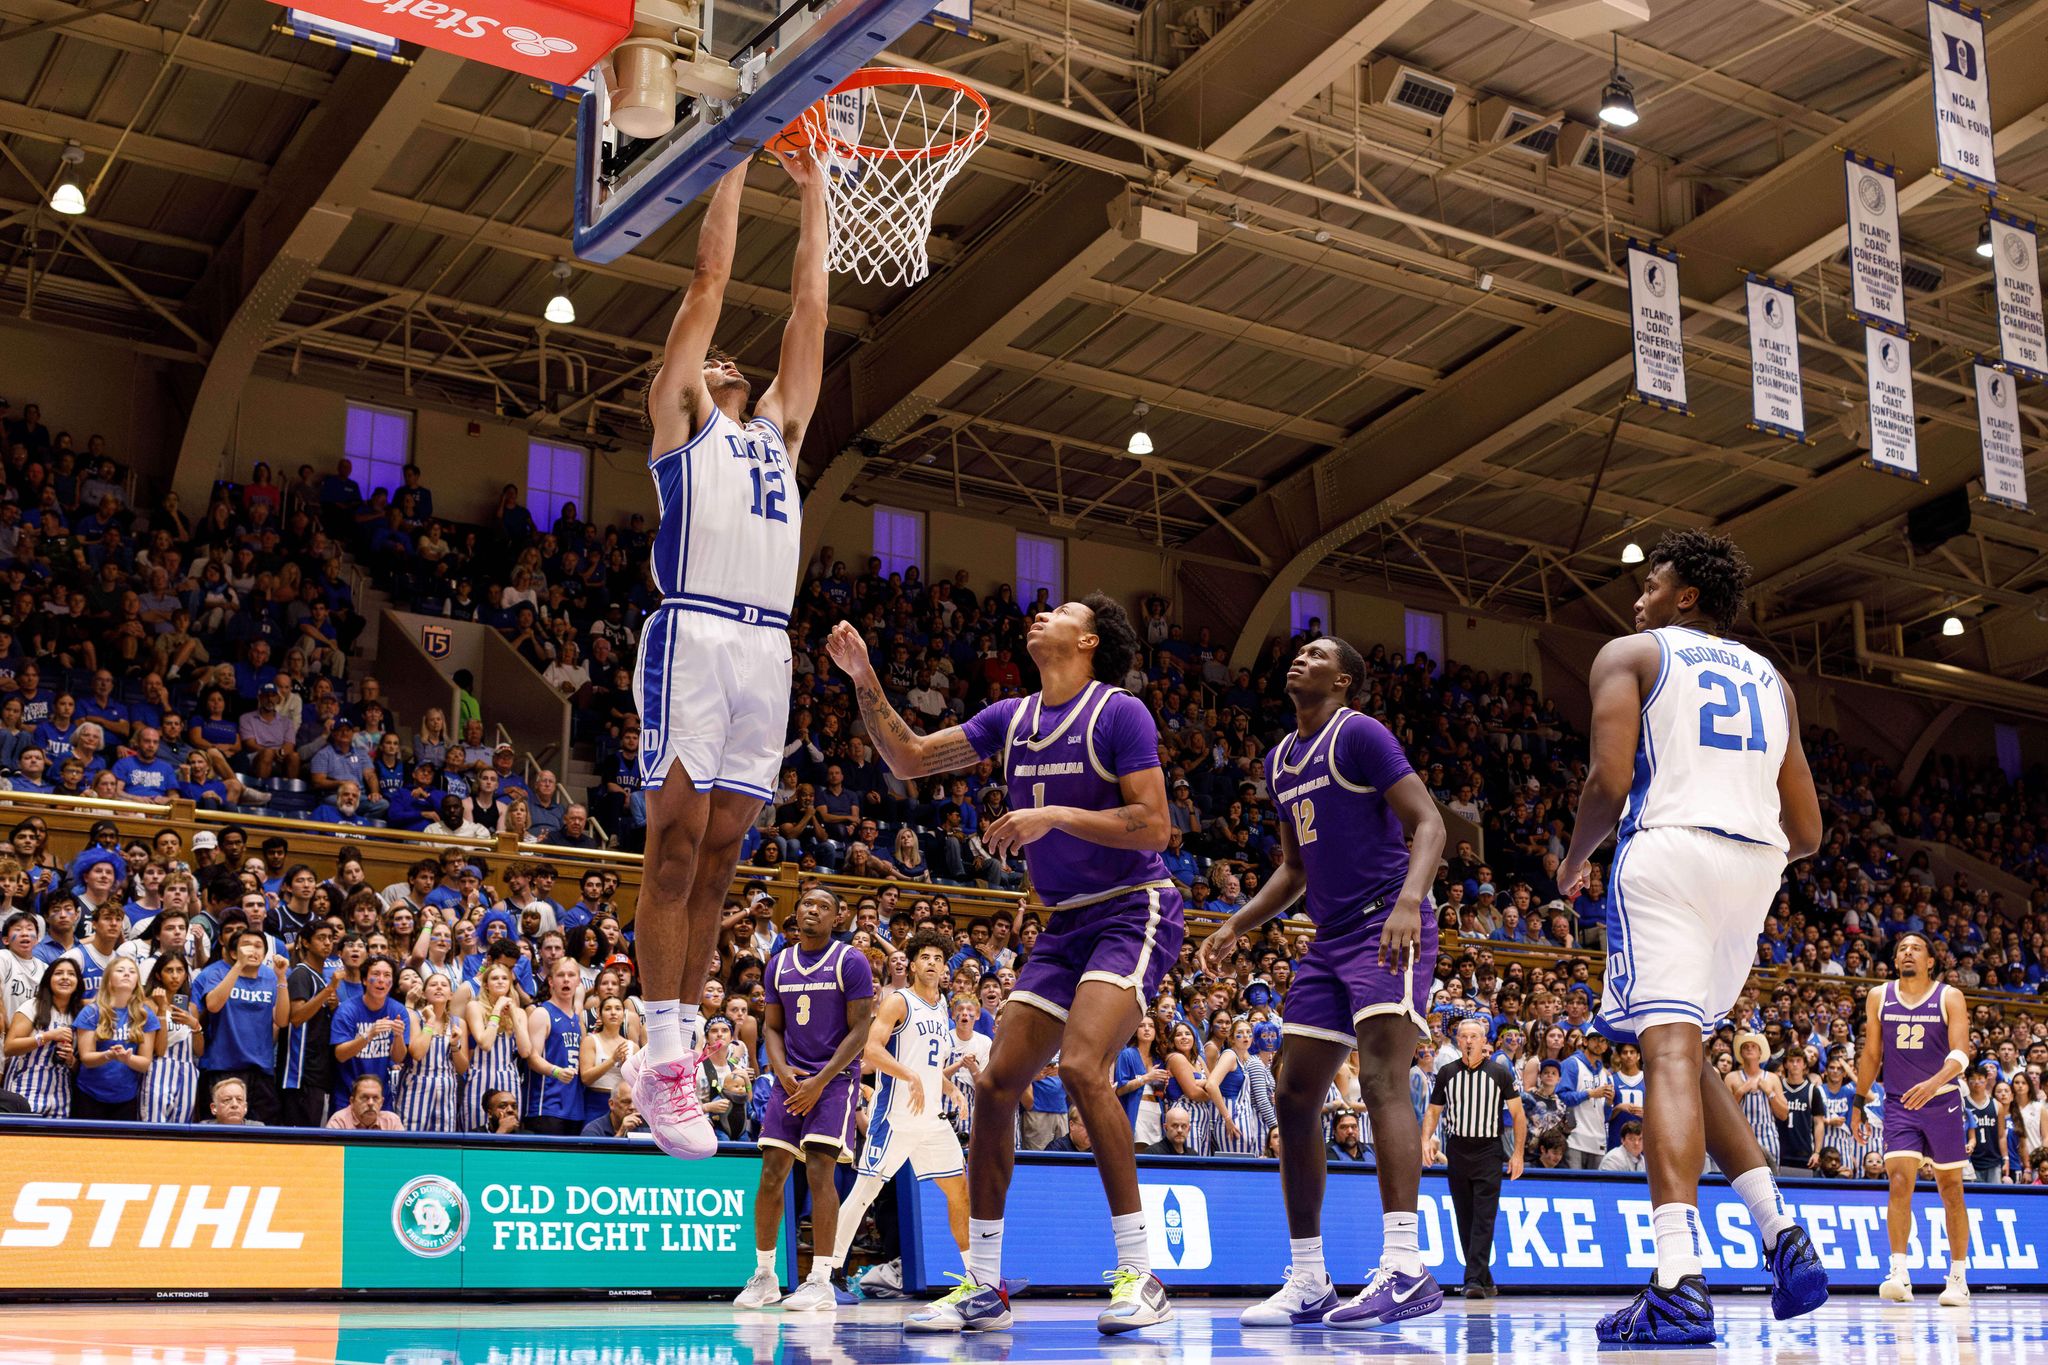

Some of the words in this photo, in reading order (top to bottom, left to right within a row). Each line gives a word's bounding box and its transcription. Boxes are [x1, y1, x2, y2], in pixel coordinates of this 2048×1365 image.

[361, 0, 501, 38] Stat
[1952, 93, 1976, 111] NCAA
[1940, 109, 1966, 128] FINAL
[1968, 120, 1990, 138] FOUR
[1958, 150, 1979, 166] 1988
[1859, 223, 1891, 243] ATLANTIC
[1865, 238, 1887, 254] COAST
[1854, 247, 1900, 272] CONFERENCE
[1857, 262, 1899, 286] CHAMPIONS
[2004, 277, 2034, 296] ATLANTIC
[2011, 292, 2031, 307] COAST
[1641, 307, 1673, 326] ATLANTIC
[2000, 301, 2043, 324] CONFERENCE
[1646, 321, 1670, 336] COAST
[2004, 315, 2043, 336] CHAMPIONS
[1637, 331, 1682, 353] CONFERENCE
[1759, 338, 1791, 355] ATLANTIC
[1640, 345, 1681, 366] CHAMPIONS
[1766, 352, 1787, 367] COAST
[1754, 362, 1799, 383] CONFERENCE
[1757, 376, 1798, 396] CHAMPIONS
[1876, 381, 1906, 399] ATLANTIC
[1882, 394, 1902, 409] COAST
[1771, 406, 1789, 420] 2009
[1872, 404, 1914, 425] CONFERENCE
[1875, 418, 1912, 437] CHAMPIONS
[725, 435, 785, 475] DUKE
[1886, 447, 1905, 461] 2010
[750, 467, 788, 524] 12
[2000, 480, 2016, 493] 2011
[428, 634, 448, 653] 15
[1674, 646, 1754, 675] NGONGBA
[1759, 670, 1774, 689] II
[1698, 670, 1767, 754] 21
[1037, 762, 1083, 776] CAROLINA
[1033, 782, 1045, 808] 1
[1291, 798, 1318, 847] 12
[83, 976, 102, 991] DU
[229, 987, 273, 1004] DUKE
[796, 995, 811, 1026] 3
[561, 1031, 582, 1048] DUK
[1896, 1024, 1925, 1049] 22
[568, 1050, 579, 1073] 5
[928, 1039, 939, 1067] 2
[1787, 1098, 1808, 1112] uke
[1979, 1127, 1986, 1144] 1
[404, 1191, 419, 1207] OLD
[481, 1184, 554, 1214] OLD
[566, 1186, 745, 1217] DOMINION
[1, 1182, 304, 1249] STIHL
[406, 1228, 438, 1247] FREIGHT
[493, 1221, 649, 1251] FREIGHT
[661, 1223, 737, 1251] LINE
